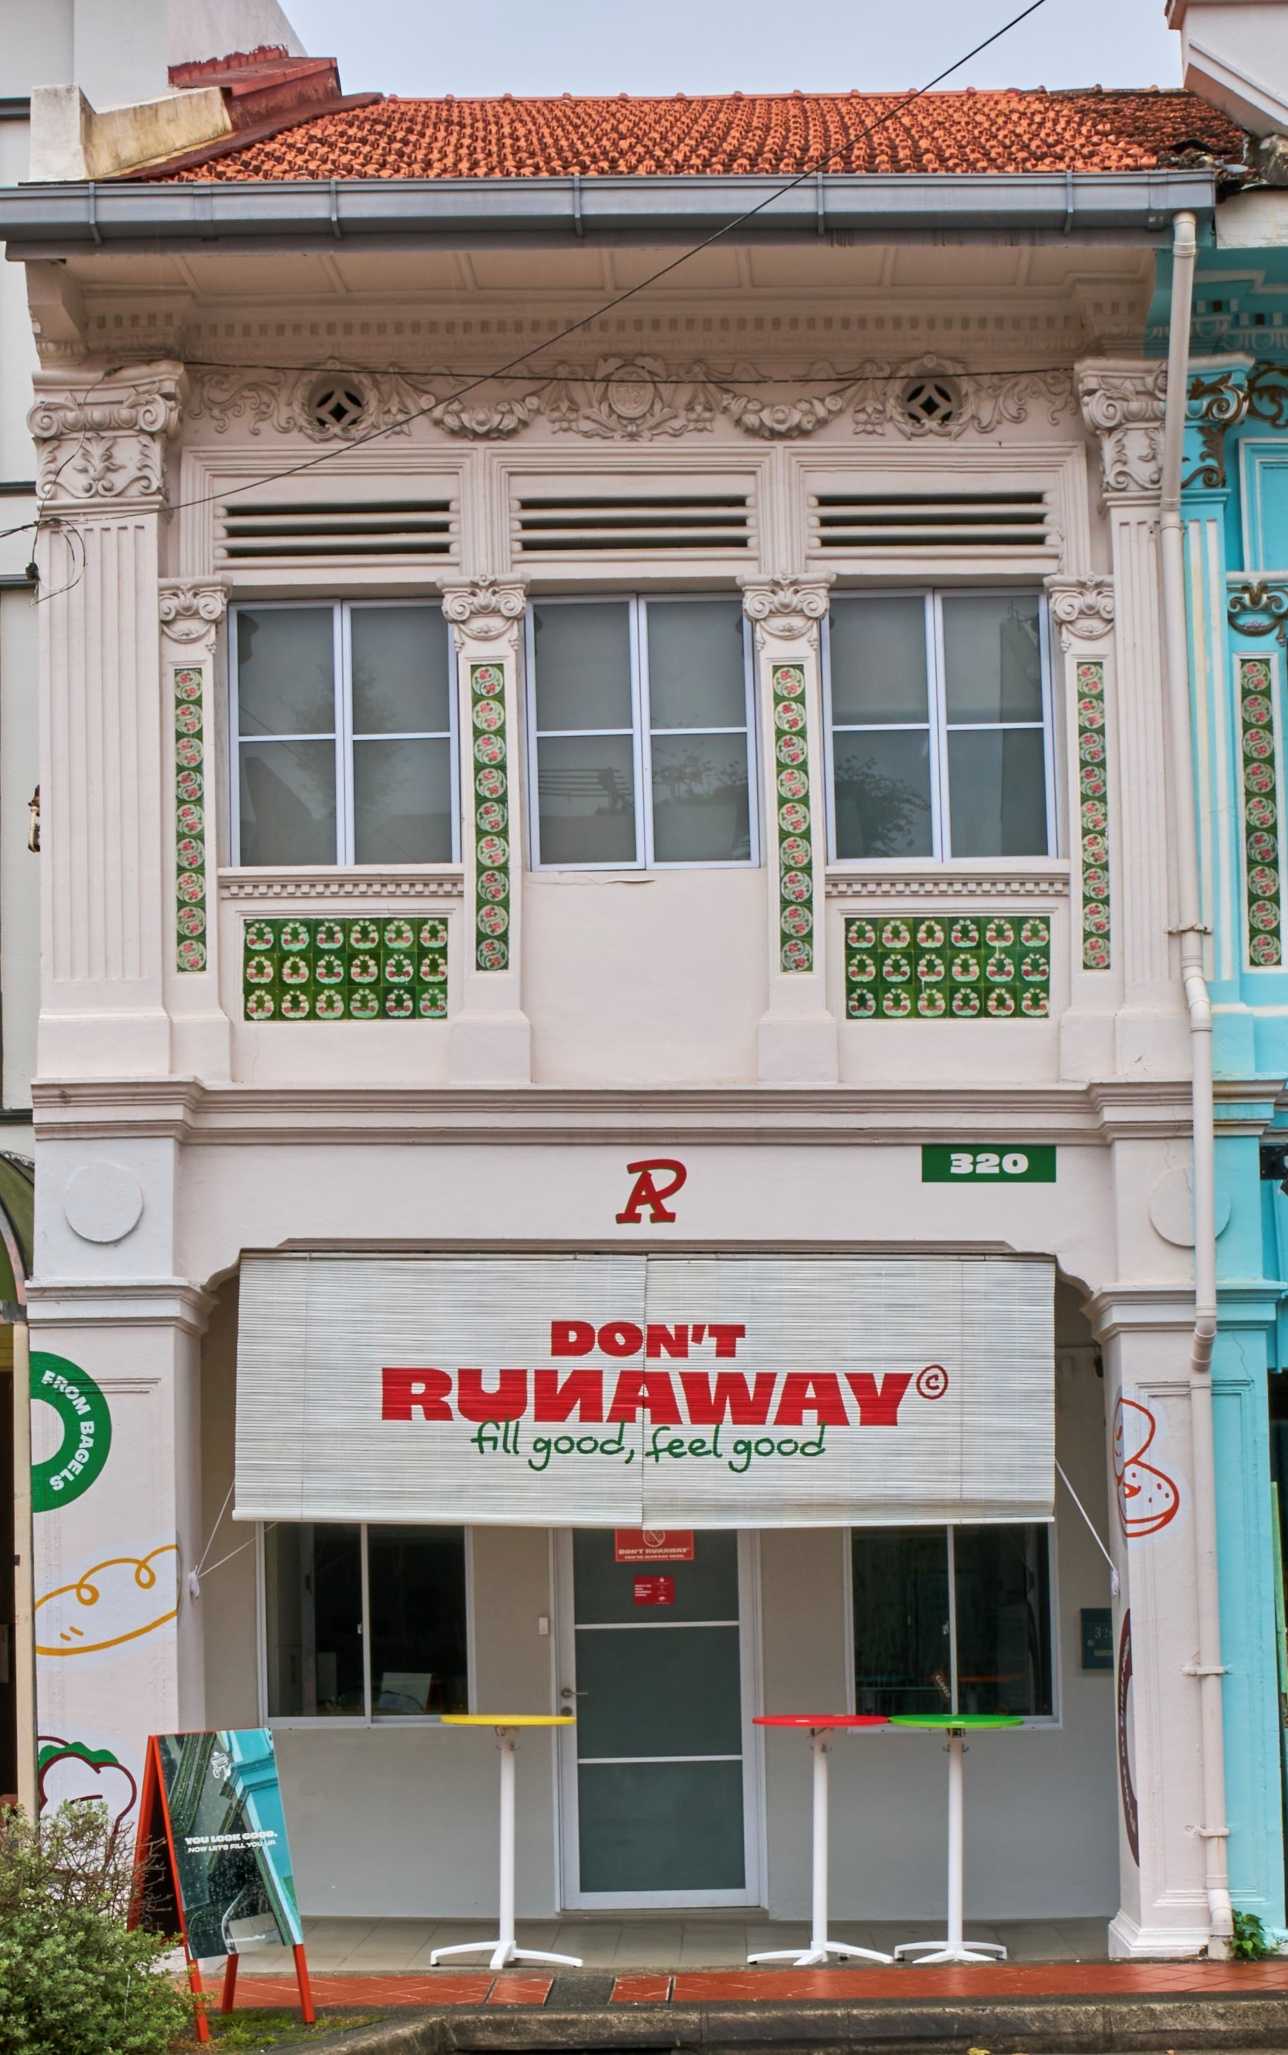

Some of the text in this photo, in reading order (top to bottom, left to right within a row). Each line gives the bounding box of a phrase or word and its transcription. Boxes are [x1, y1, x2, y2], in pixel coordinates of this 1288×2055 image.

[949, 1152, 1029, 1175] 320
[550, 1320, 746, 1358] DON'T
[41, 1369, 95, 1491] FROM BAGELS
[470, 1419, 827, 1474] fill good, feel good
[185, 1836, 209, 1845] YOU
[211, 1833, 241, 1843] LOOK
[188, 1845, 207, 1854] NOW
[246, 1840, 263, 1848] YOU
